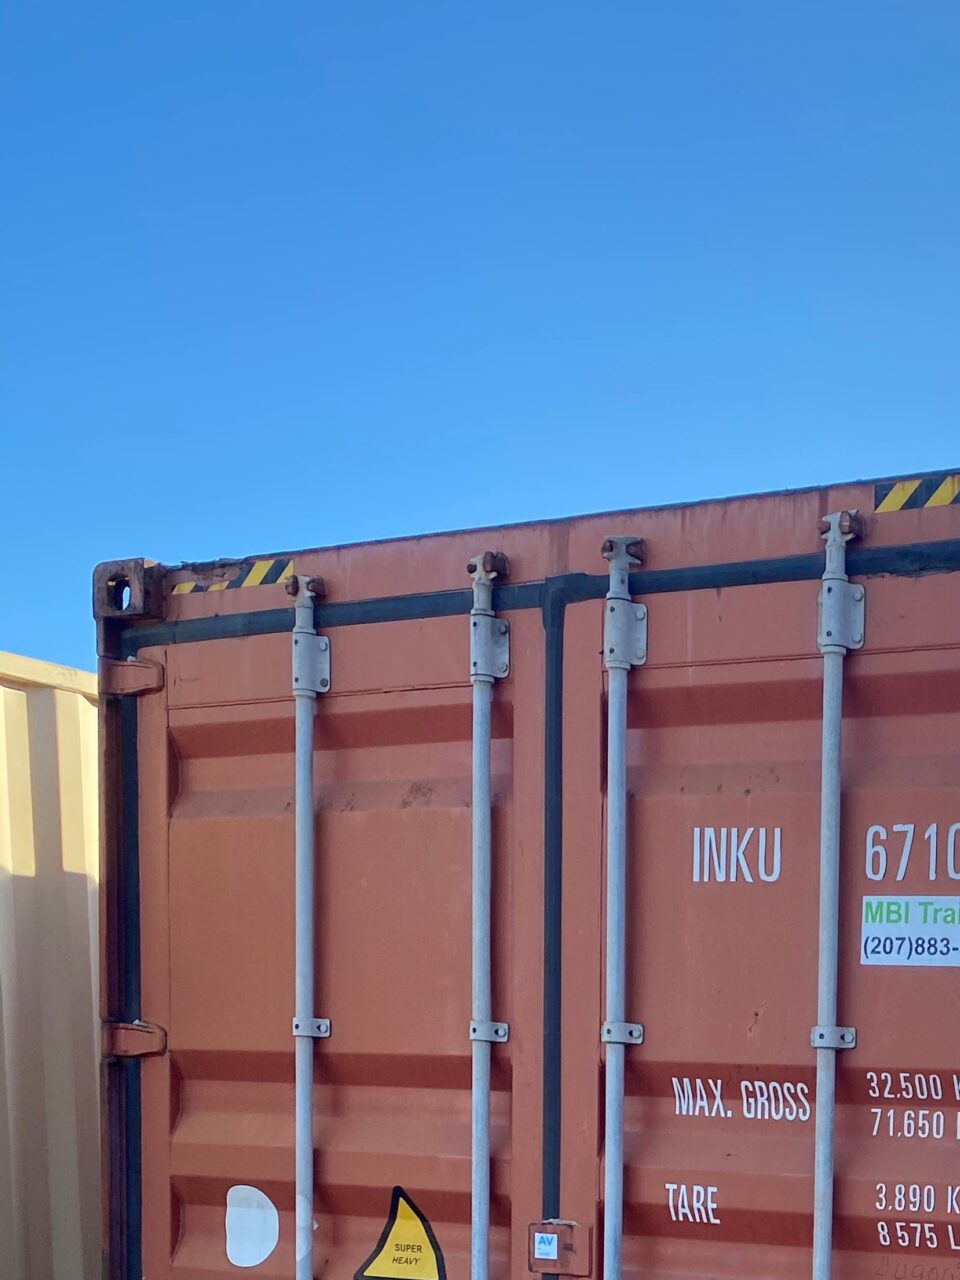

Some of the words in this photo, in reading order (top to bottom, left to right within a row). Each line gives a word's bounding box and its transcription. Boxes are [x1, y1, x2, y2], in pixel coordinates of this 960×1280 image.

[692, 827, 781, 883] INKU
[864, 901, 910, 925] MBI
[671, 1077, 733, 1118] MAX.
[740, 1080, 811, 1121] GROSS
[665, 1183, 721, 1225] TARE
[875, 1183, 936, 1213] 3,890
[391, 1256, 420, 1265] HEAVY
[394, 1243, 422, 1253] SUPER
